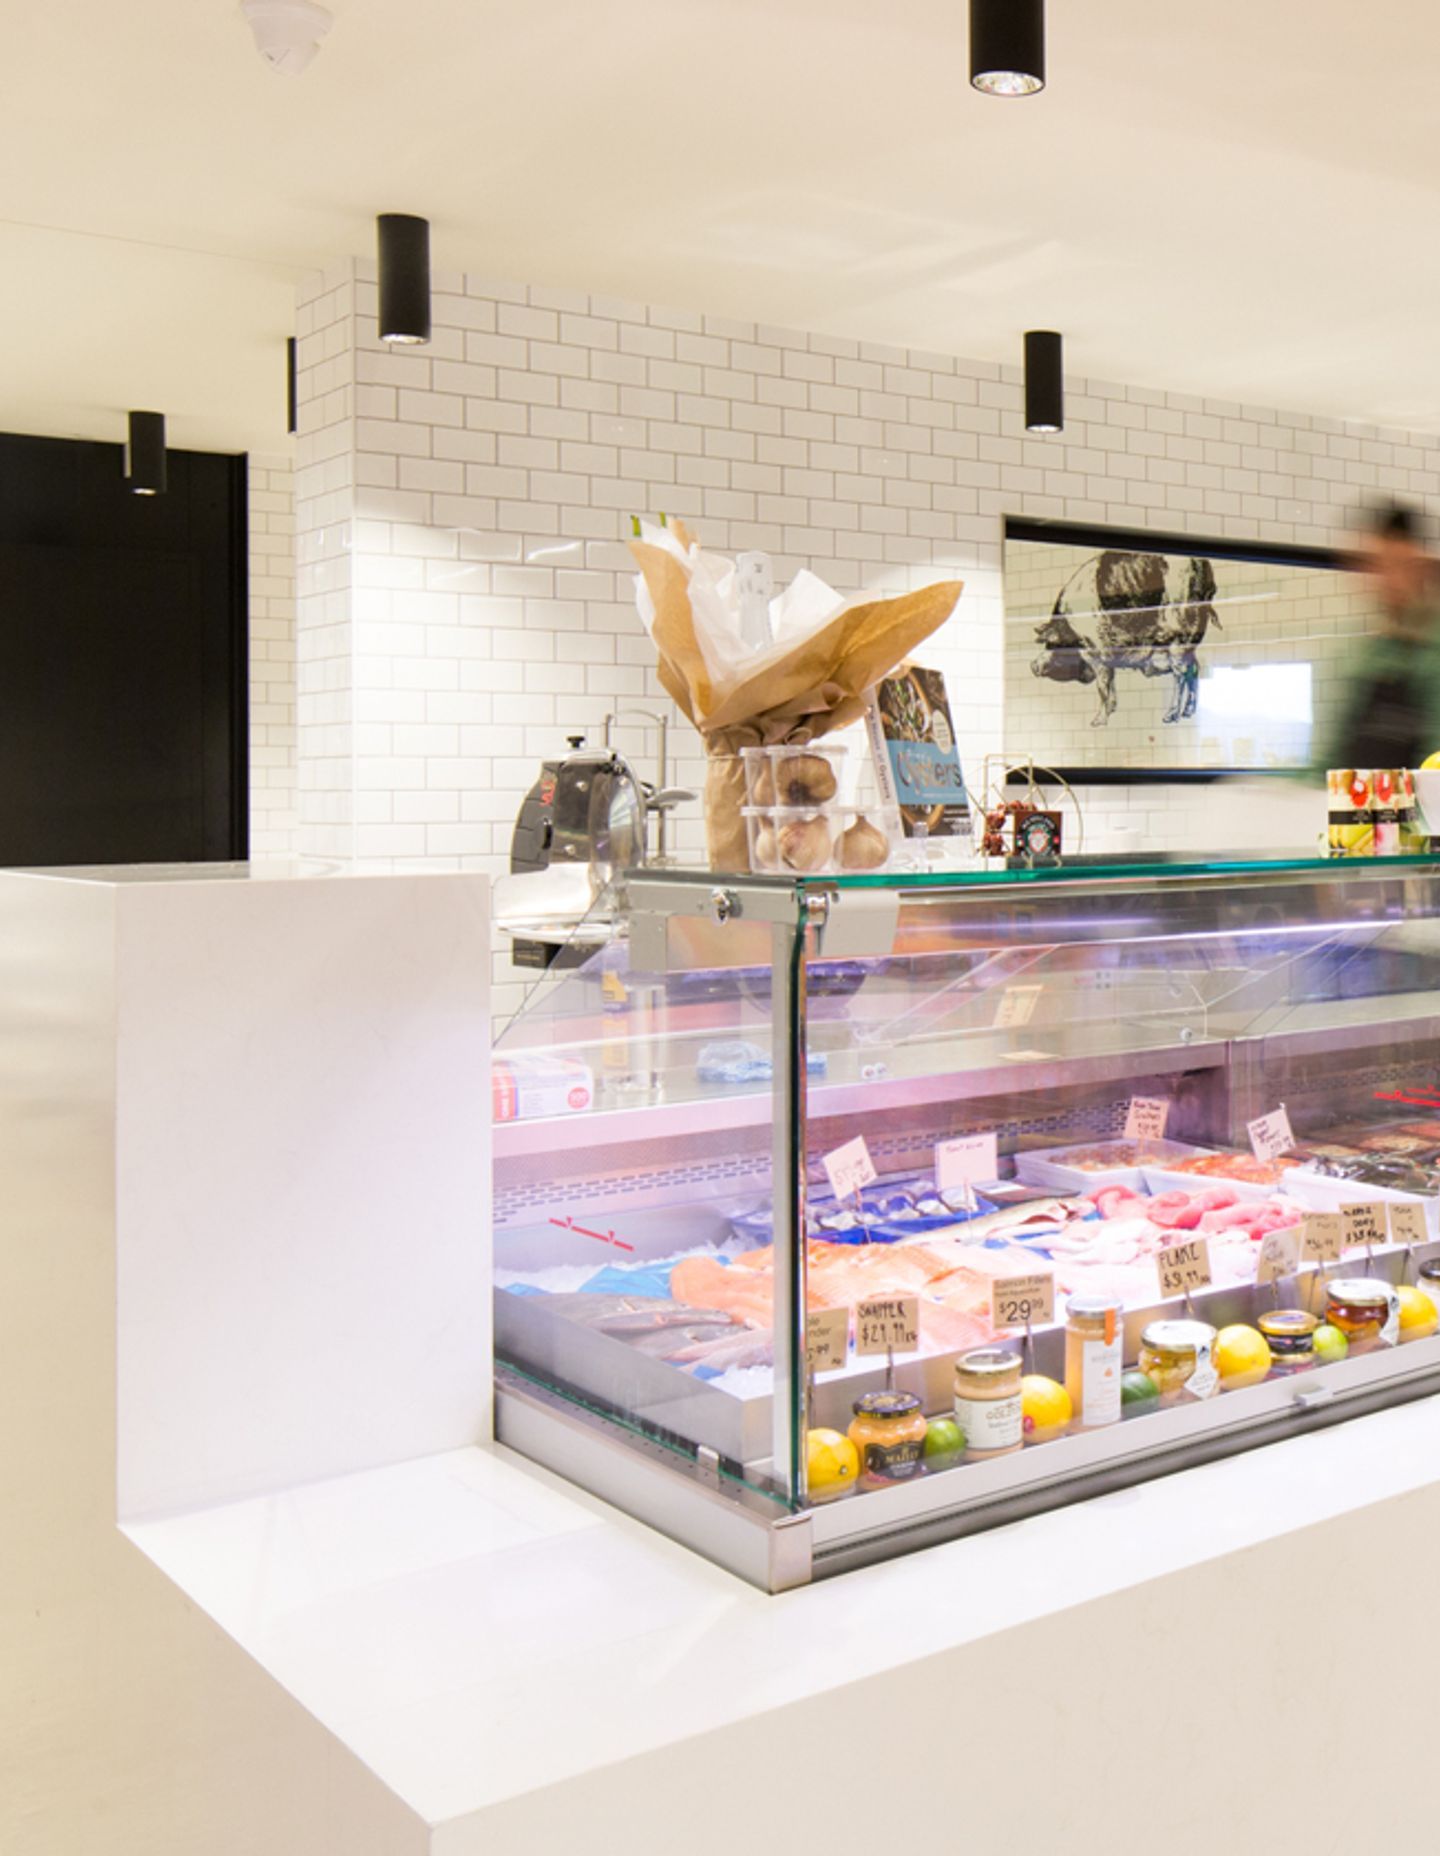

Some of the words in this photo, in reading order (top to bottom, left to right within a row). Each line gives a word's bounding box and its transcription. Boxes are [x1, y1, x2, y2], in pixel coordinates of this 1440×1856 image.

[879, 763, 891, 800] Oysters
[896, 750, 963, 796] Oysters
[1159, 1242, 1201, 1269] FLAKE
